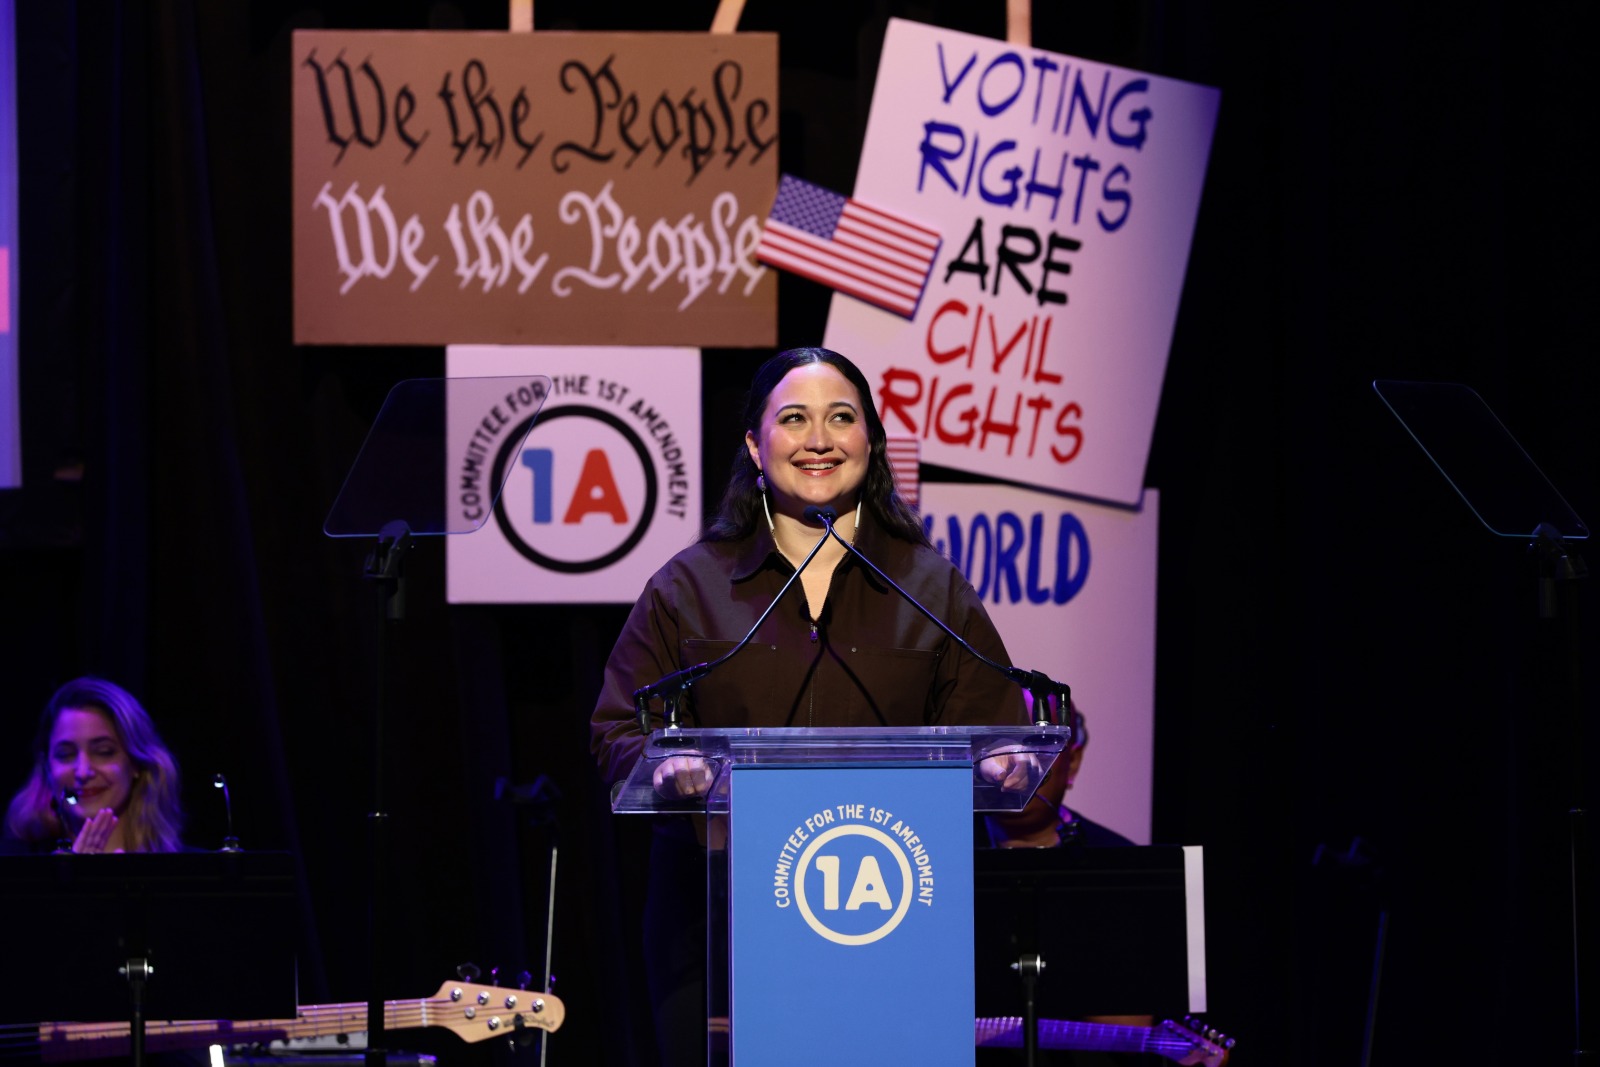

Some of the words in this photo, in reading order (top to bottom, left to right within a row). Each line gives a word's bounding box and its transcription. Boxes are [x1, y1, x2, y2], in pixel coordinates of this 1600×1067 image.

[301, 48, 430, 168] We
[437, 58, 545, 170] the
[551, 53, 777, 187] People
[937, 41, 1153, 152] VOTING
[917, 119, 1132, 232] RIGHTS
[312, 181, 439, 295] We
[444, 189, 549, 294] the
[551, 180, 768, 312] People
[944, 217, 1083, 306] ARE
[926, 299, 1064, 386] CIVIL
[460, 405, 509, 521] COMMITTEE
[505, 380, 546, 415] FOR
[552, 374, 590, 396] THE
[598, 379, 631, 406] 1ST
[628, 398, 689, 521] AMENDMENT
[878, 366, 1085, 465] RIGHTS
[521, 447, 629, 525] 1A
[774, 826, 809, 908] COMMITTEE
[804, 808, 835, 833] FOR
[837, 804, 865, 820] THE
[869, 806, 893, 826] 1ST
[890, 820, 934, 907] AMENDMENT
[815, 855, 893, 911] 1A
